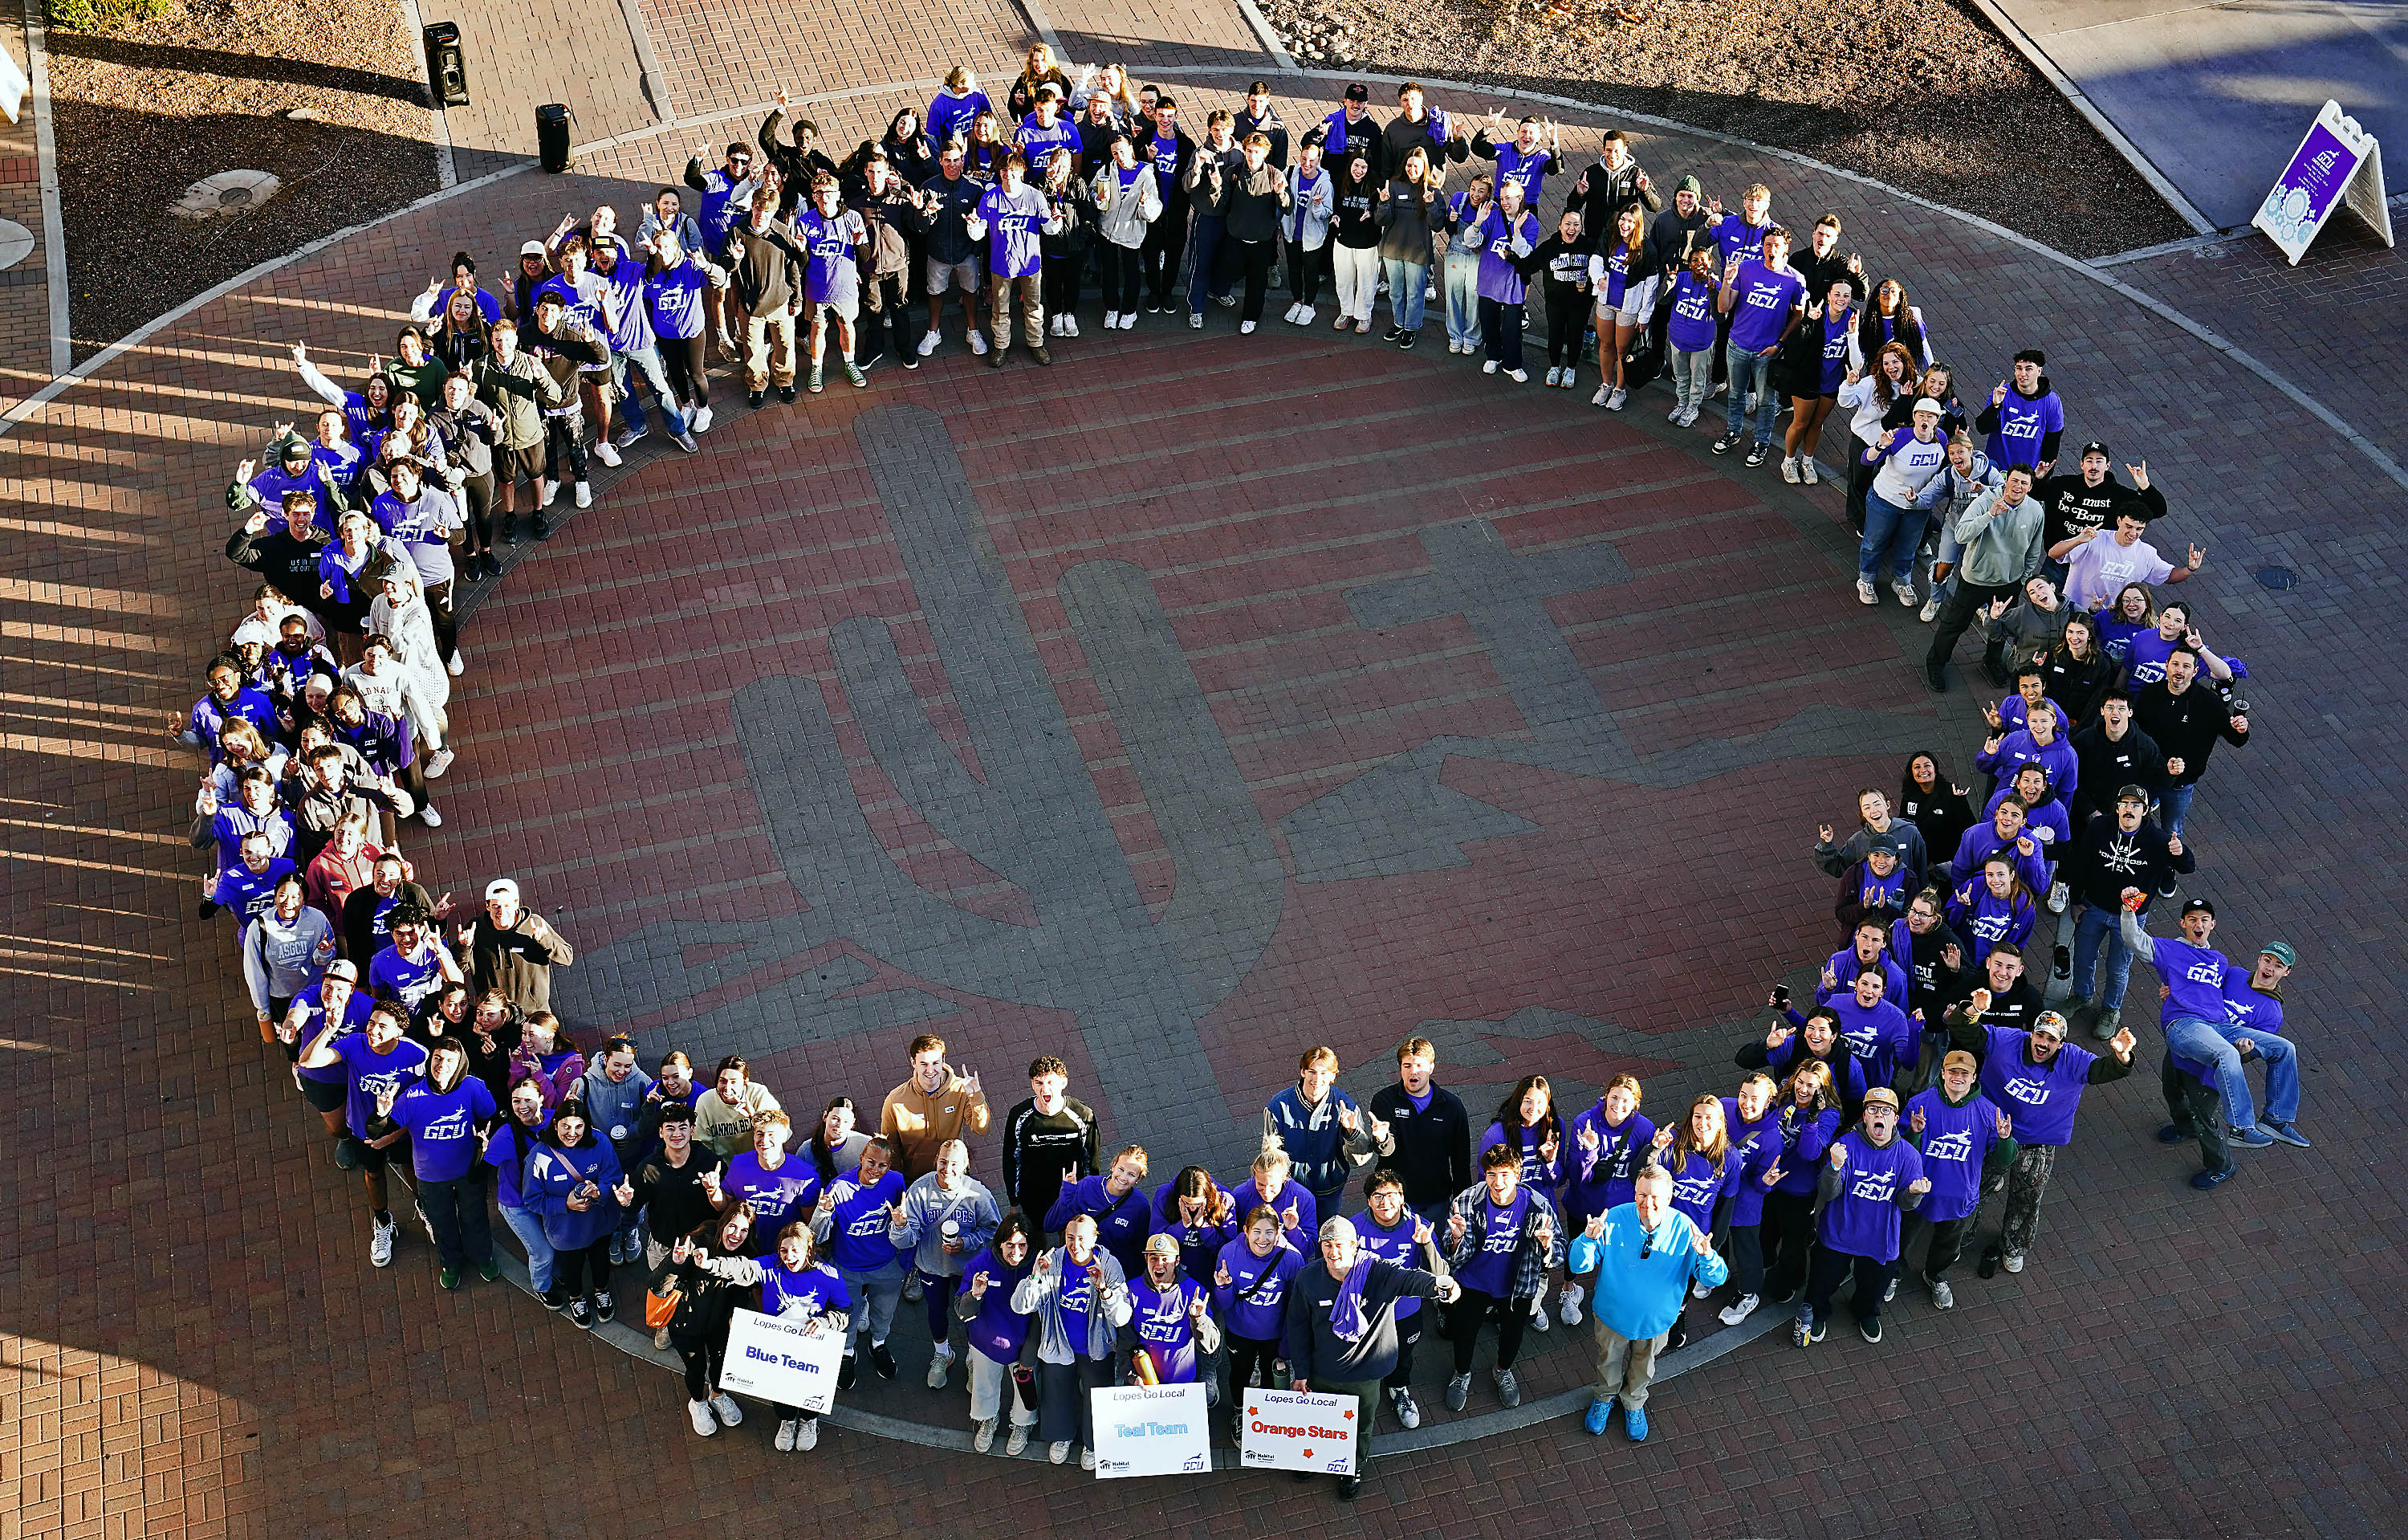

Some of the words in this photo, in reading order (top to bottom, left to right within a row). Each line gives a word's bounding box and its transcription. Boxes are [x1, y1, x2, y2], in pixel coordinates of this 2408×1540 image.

[1032, 155, 1051, 168] GC
[1157, 160, 1177, 174] CU
[2316, 151, 2335, 169] GCU
[998, 217, 1030, 231] GCU
[813, 242, 847, 257] GCU
[1491, 239, 1511, 253] GC
[658, 295, 687, 311] GCU
[1747, 291, 1780, 310] GCU
[1675, 300, 1706, 321] GCU
[2002, 422, 2040, 439] GCU
[1909, 453, 1940, 466] GCU
[2062, 491, 2074, 502] ye
[2082, 497, 2112, 507] must
[2058, 500, 2070, 512] be
[2072, 507, 2105, 521] Born
[392, 528, 427, 542] GCU
[2100, 560, 2136, 578] GCU
[364, 688, 372, 697] LD
[246, 898, 277, 914] GC
[1971, 919, 2008, 942] GCU
[278, 941, 308, 959] ASGCU
[1914, 964, 1933, 979] CU
[2186, 966, 2223, 989] GCU
[2003, 1077, 2051, 1105] GCU
[424, 1122, 469, 1140] GCU
[1925, 1139, 1972, 1163] GCU
[1670, 1181, 1713, 1206] GCU
[1852, 1181, 1896, 1202] GCU
[846, 1218, 888, 1236] GCU
[1115, 1217, 1129, 1228] GCU
[1482, 1239, 1518, 1253] GCU
[753, 1317, 783, 1333] Lopes
[783, 1324, 798, 1335] Go
[1139, 1322, 1183, 1342] GCU
[746, 1345, 779, 1364] Blue
[781, 1354, 820, 1375] Team
[1113, 1391, 1142, 1403] Lopes
[1144, 1390, 1158, 1399] Go
[1159, 1388, 1186, 1399] Local
[1264, 1393, 1294, 1407] Lopes
[1296, 1395, 1310, 1405] Go
[1311, 1398, 1337, 1408] Local
[803, 1399, 824, 1410] GCU
[1116, 1422, 1146, 1438] Teal
[1147, 1418, 1189, 1436] Team
[1251, 1420, 1307, 1439] Orange
[1308, 1425, 1348, 1440] Stars
[1183, 1461, 1205, 1471] GCU
[1327, 1462, 1348, 1473] GCU
